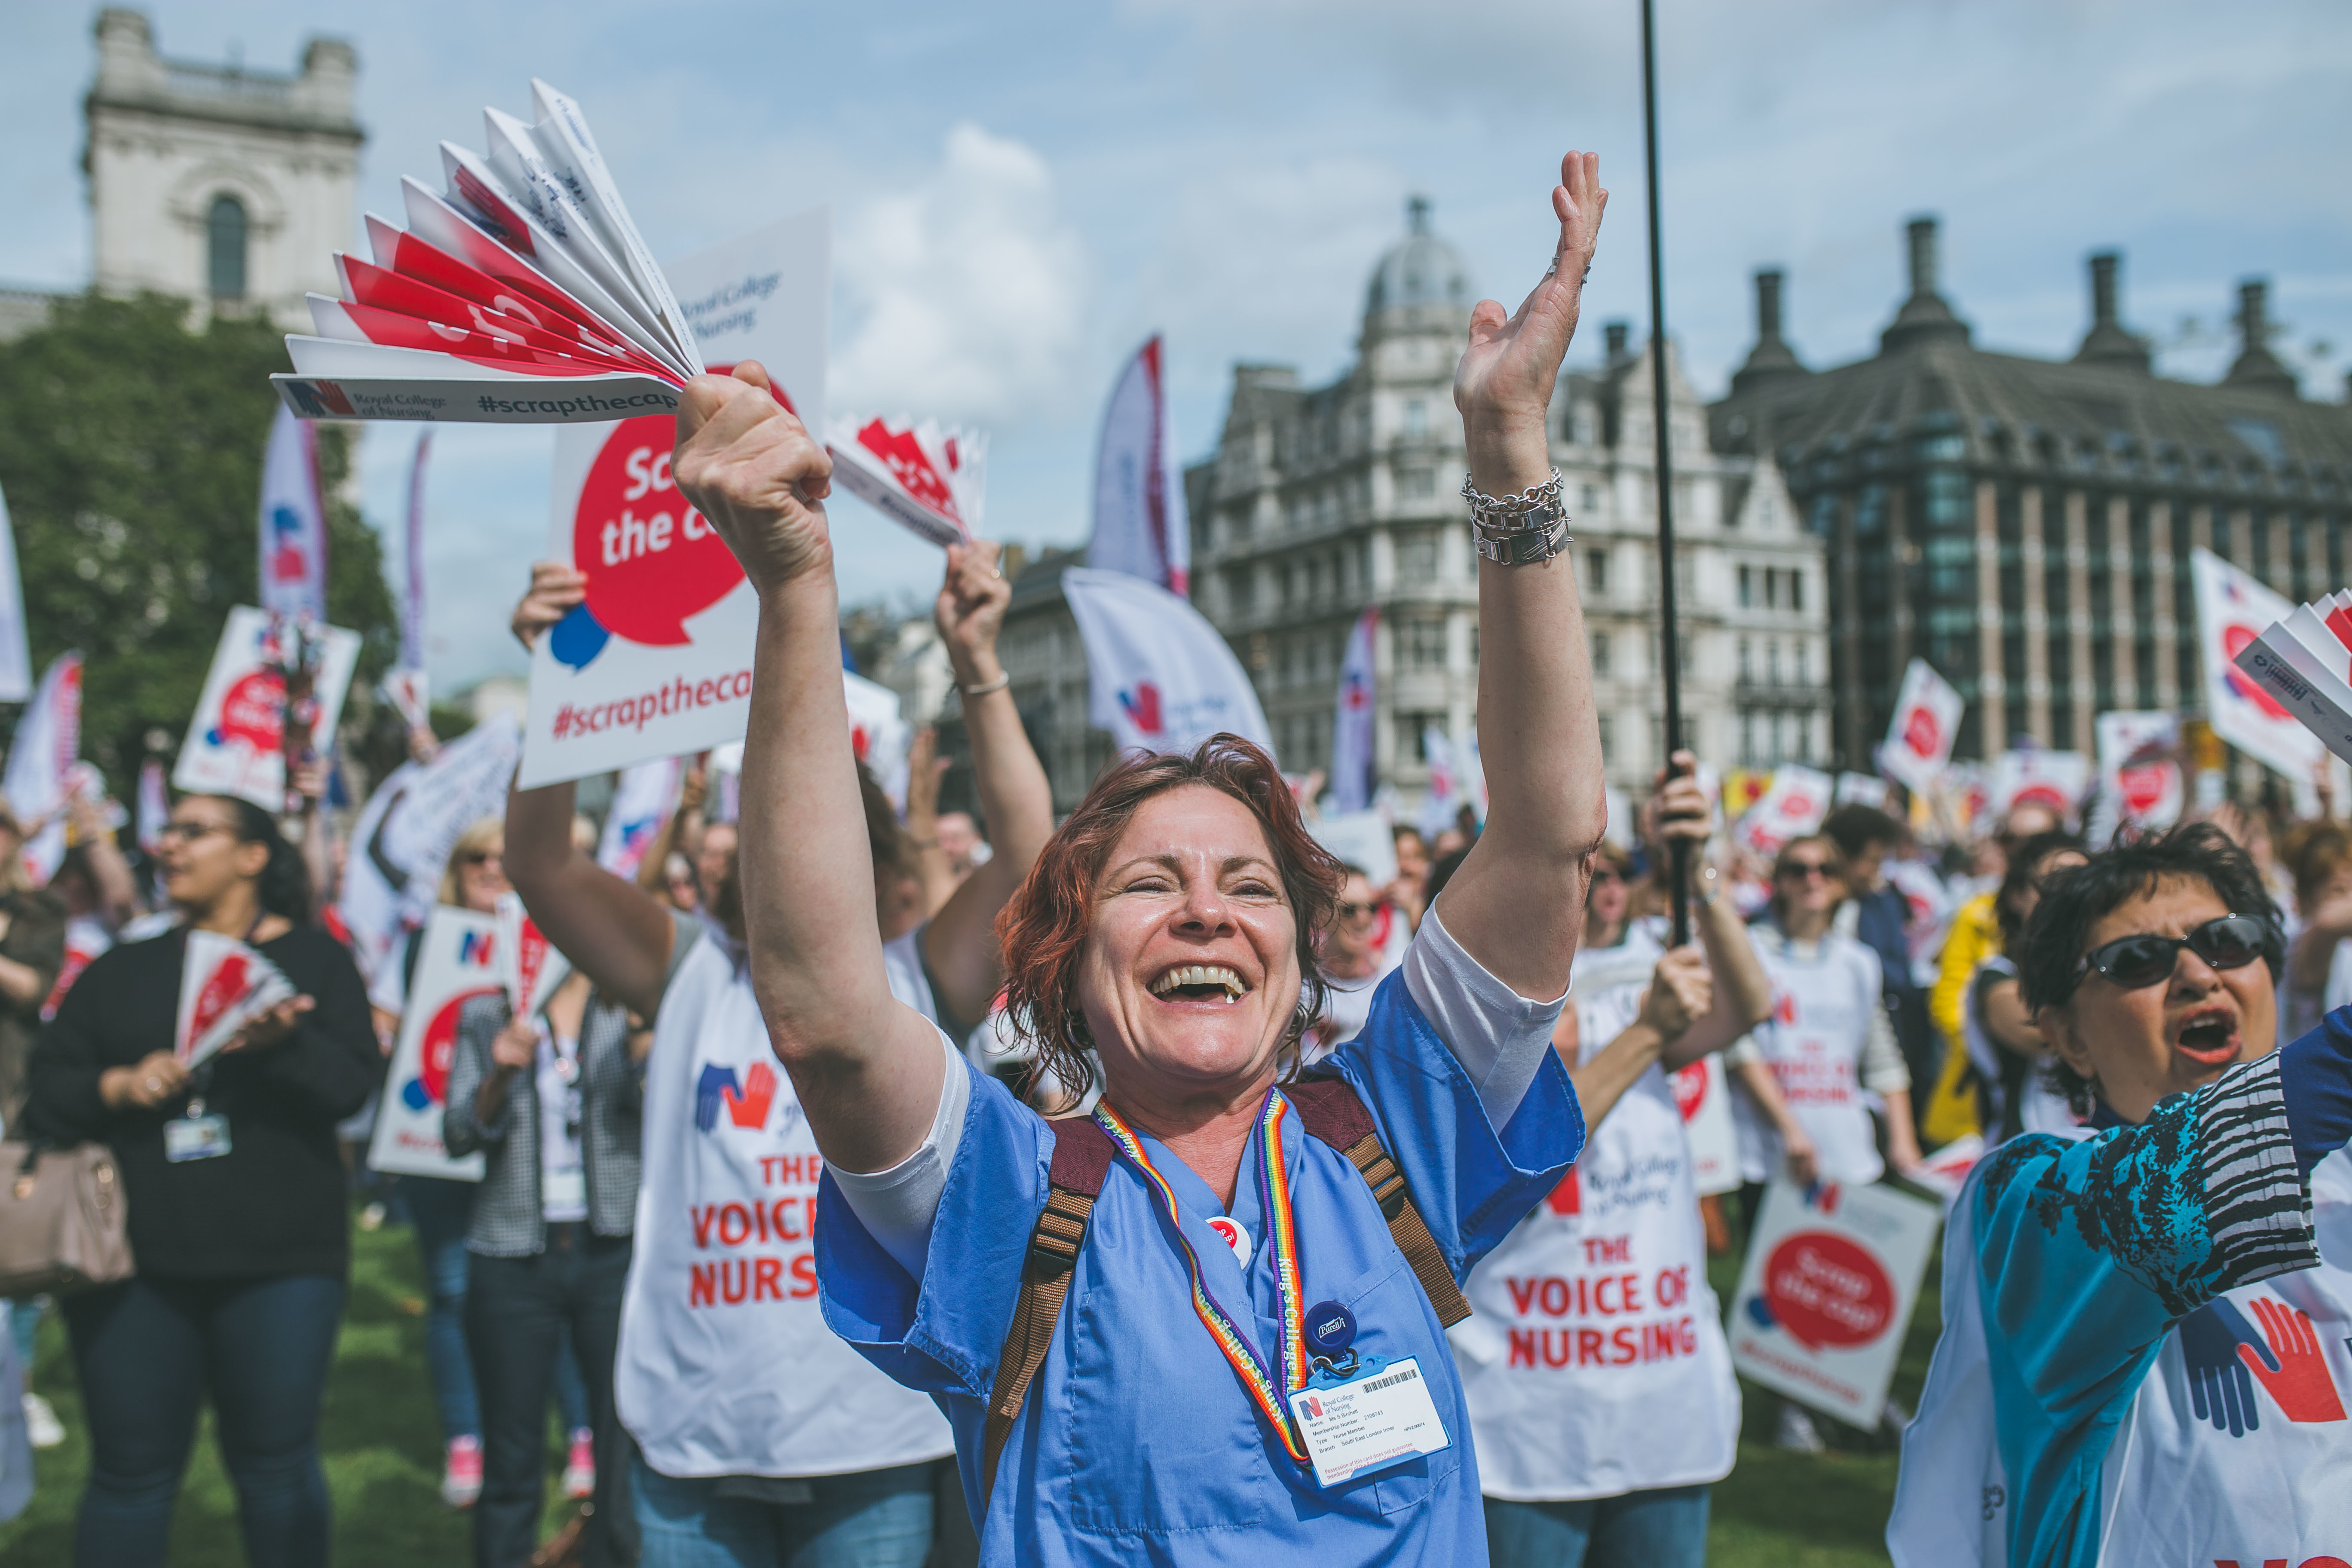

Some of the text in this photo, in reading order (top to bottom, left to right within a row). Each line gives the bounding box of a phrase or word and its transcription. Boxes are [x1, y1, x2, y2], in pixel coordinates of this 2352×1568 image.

[353, 392, 679, 417] Royal College #scrapthecap
[362, 405, 436, 420] of Nursing
[623, 446, 677, 502] Sc
[600, 506, 720, 566] the c
[553, 669, 751, 741] #scraptheca
[1112, 1128, 1141, 1158] King's
[760, 1155, 824, 1186] THE
[1582, 1234, 1633, 1263] THE
[690, 1254, 818, 1309] NURS
[1278, 1257, 1297, 1303] King's
[1507, 1265, 1689, 1318] VOICE OF
[1211, 1314, 1255, 1370] College
[1283, 1308, 1300, 1371] College
[1320, 1320, 1340, 1335] Purell
[1508, 1317, 1697, 1369] NURSING
[1252, 1369, 1285, 1424] King's
[1322, 1393, 1355, 1407] Royal College
[1331, 1403, 1351, 1413] Nursing
[1313, 1425, 1340, 1436] Membership
[1364, 1410, 1384, 1420] 2108743
[1341, 1409, 1358, 1418] Birchett
[1341, 1438, 1354, 1446] South
[1366, 1429, 1383, 1439] London
[1348, 1426, 1366, 1435] Member
[1325, 1464, 1349, 1474] Possession
[1363, 1454, 1372, 1462] card
[1392, 1442, 1413, 1453] guarantee
[1327, 1467, 1354, 1479] membership
